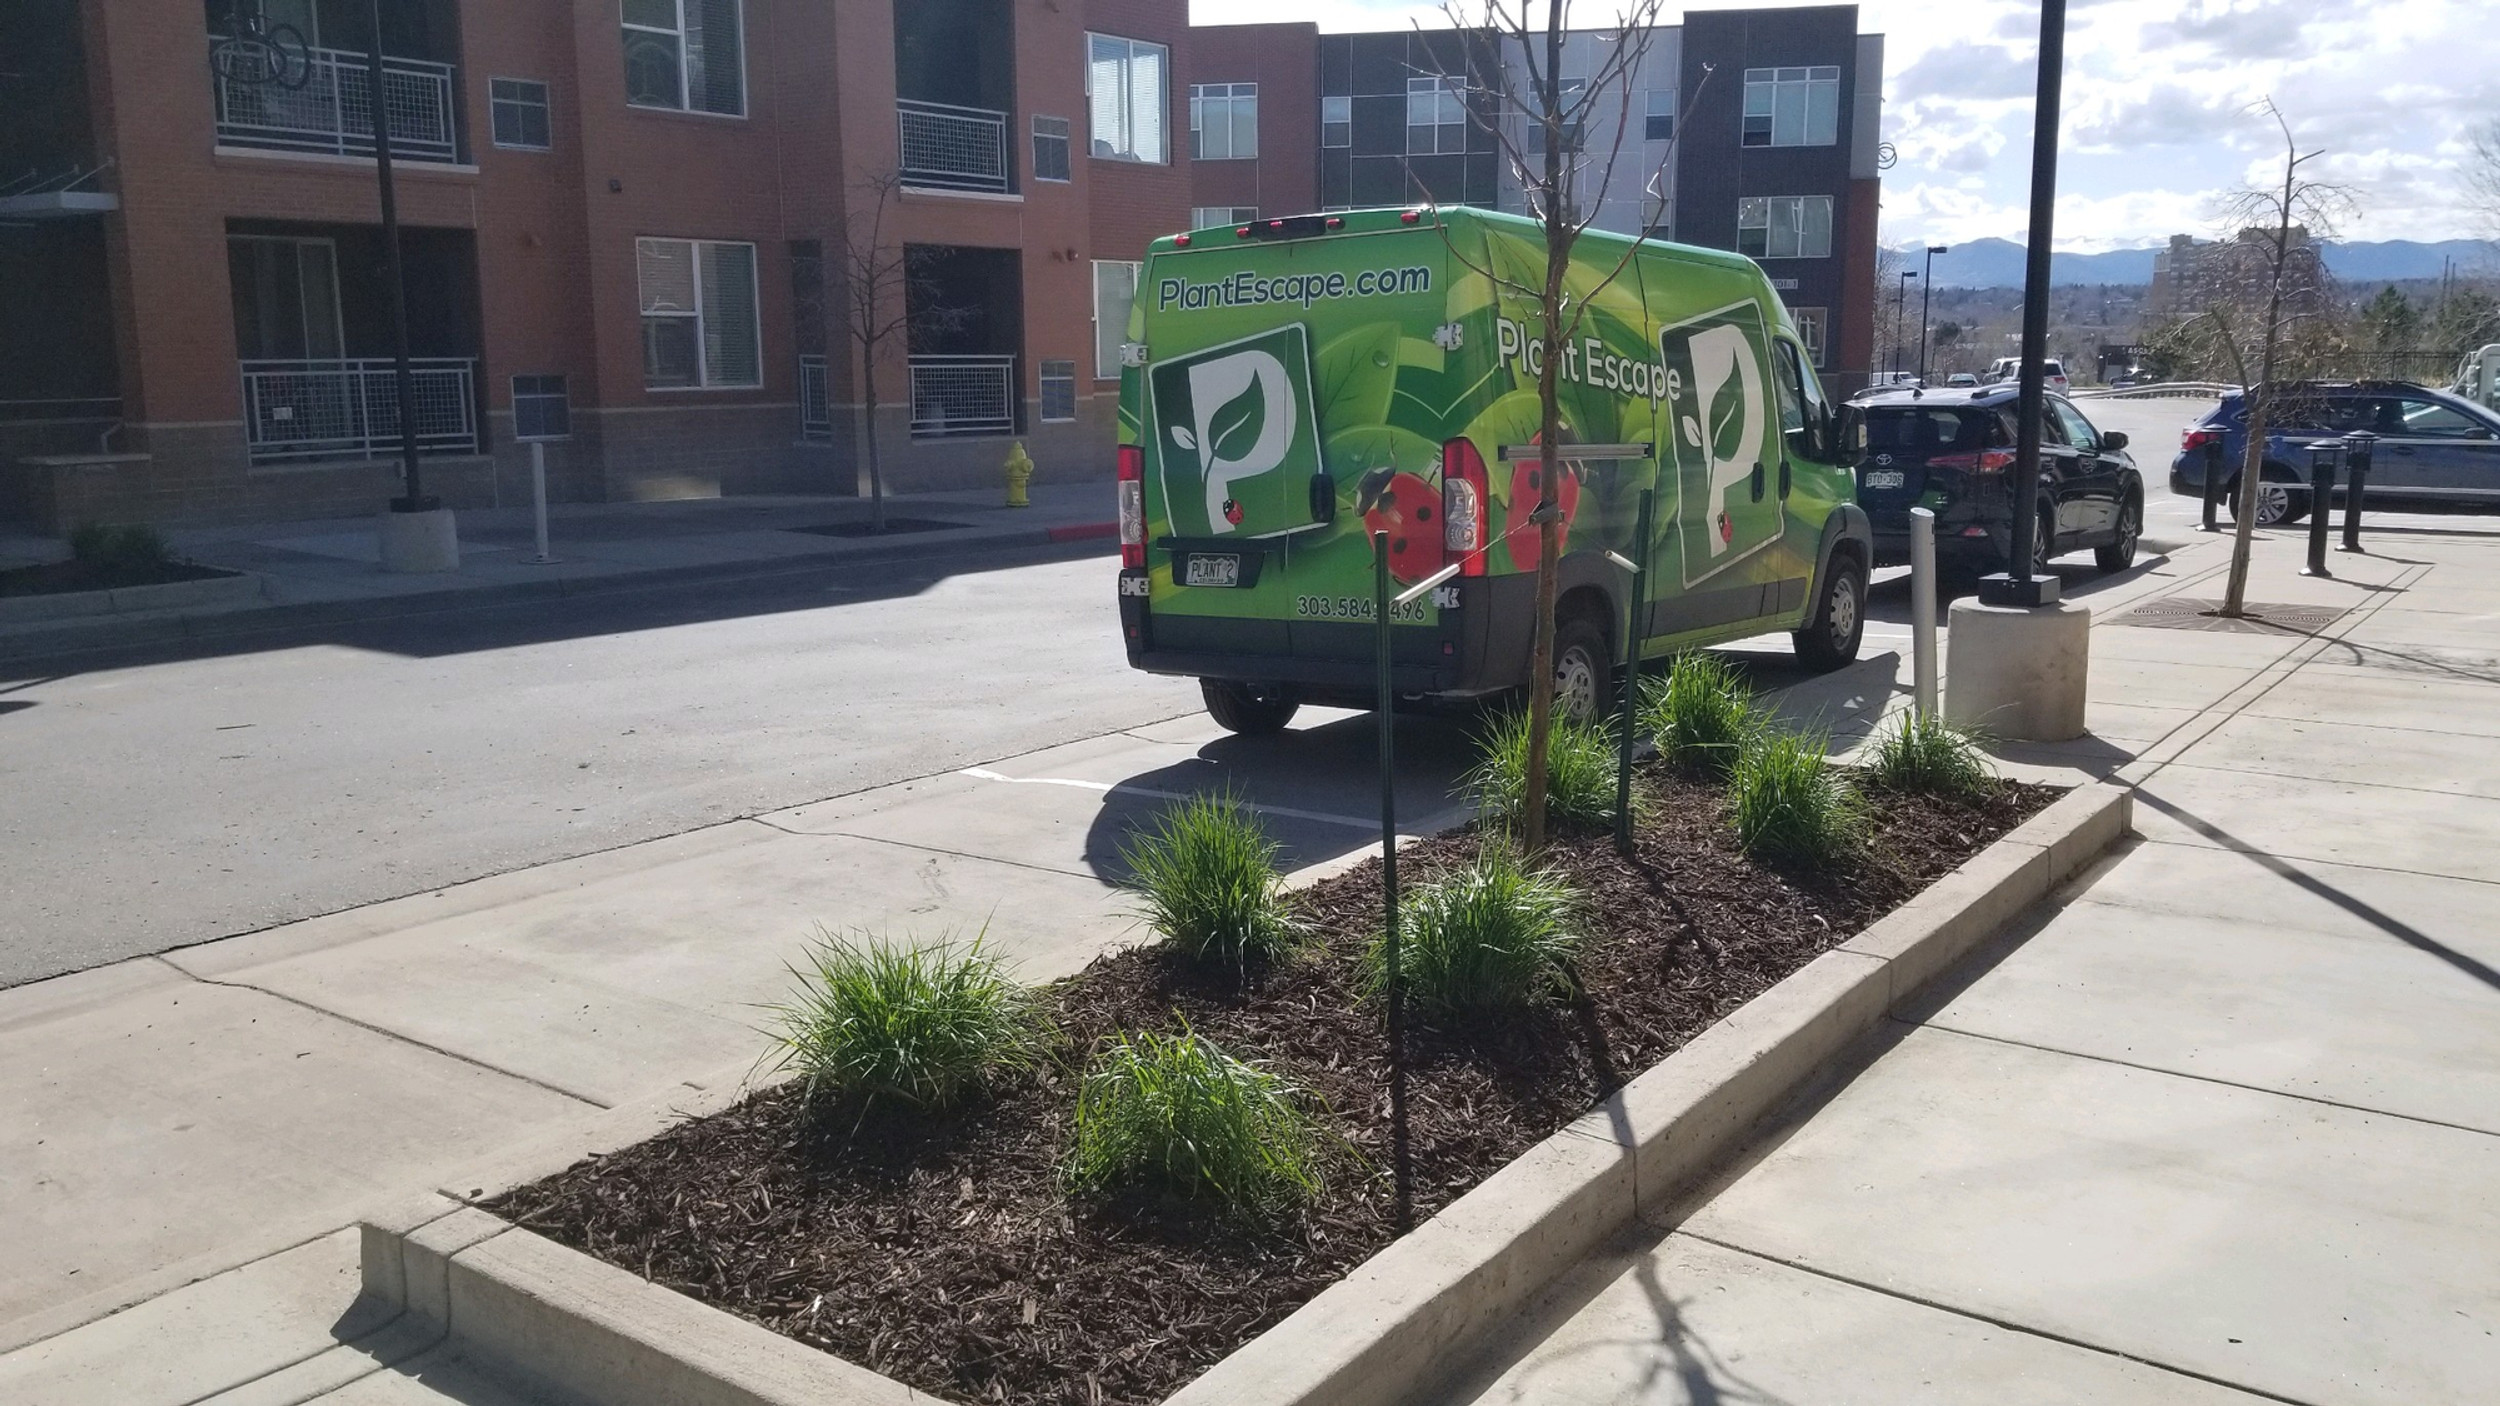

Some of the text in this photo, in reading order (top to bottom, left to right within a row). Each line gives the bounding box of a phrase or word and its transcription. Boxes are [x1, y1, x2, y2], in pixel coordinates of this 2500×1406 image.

[1159, 266, 1431, 311] PlantEscape.com
[1585, 337, 1682, 410] Escape
[1191, 562, 1222, 578] PLANT
[1297, 596, 1426, 622] 303.584.496
